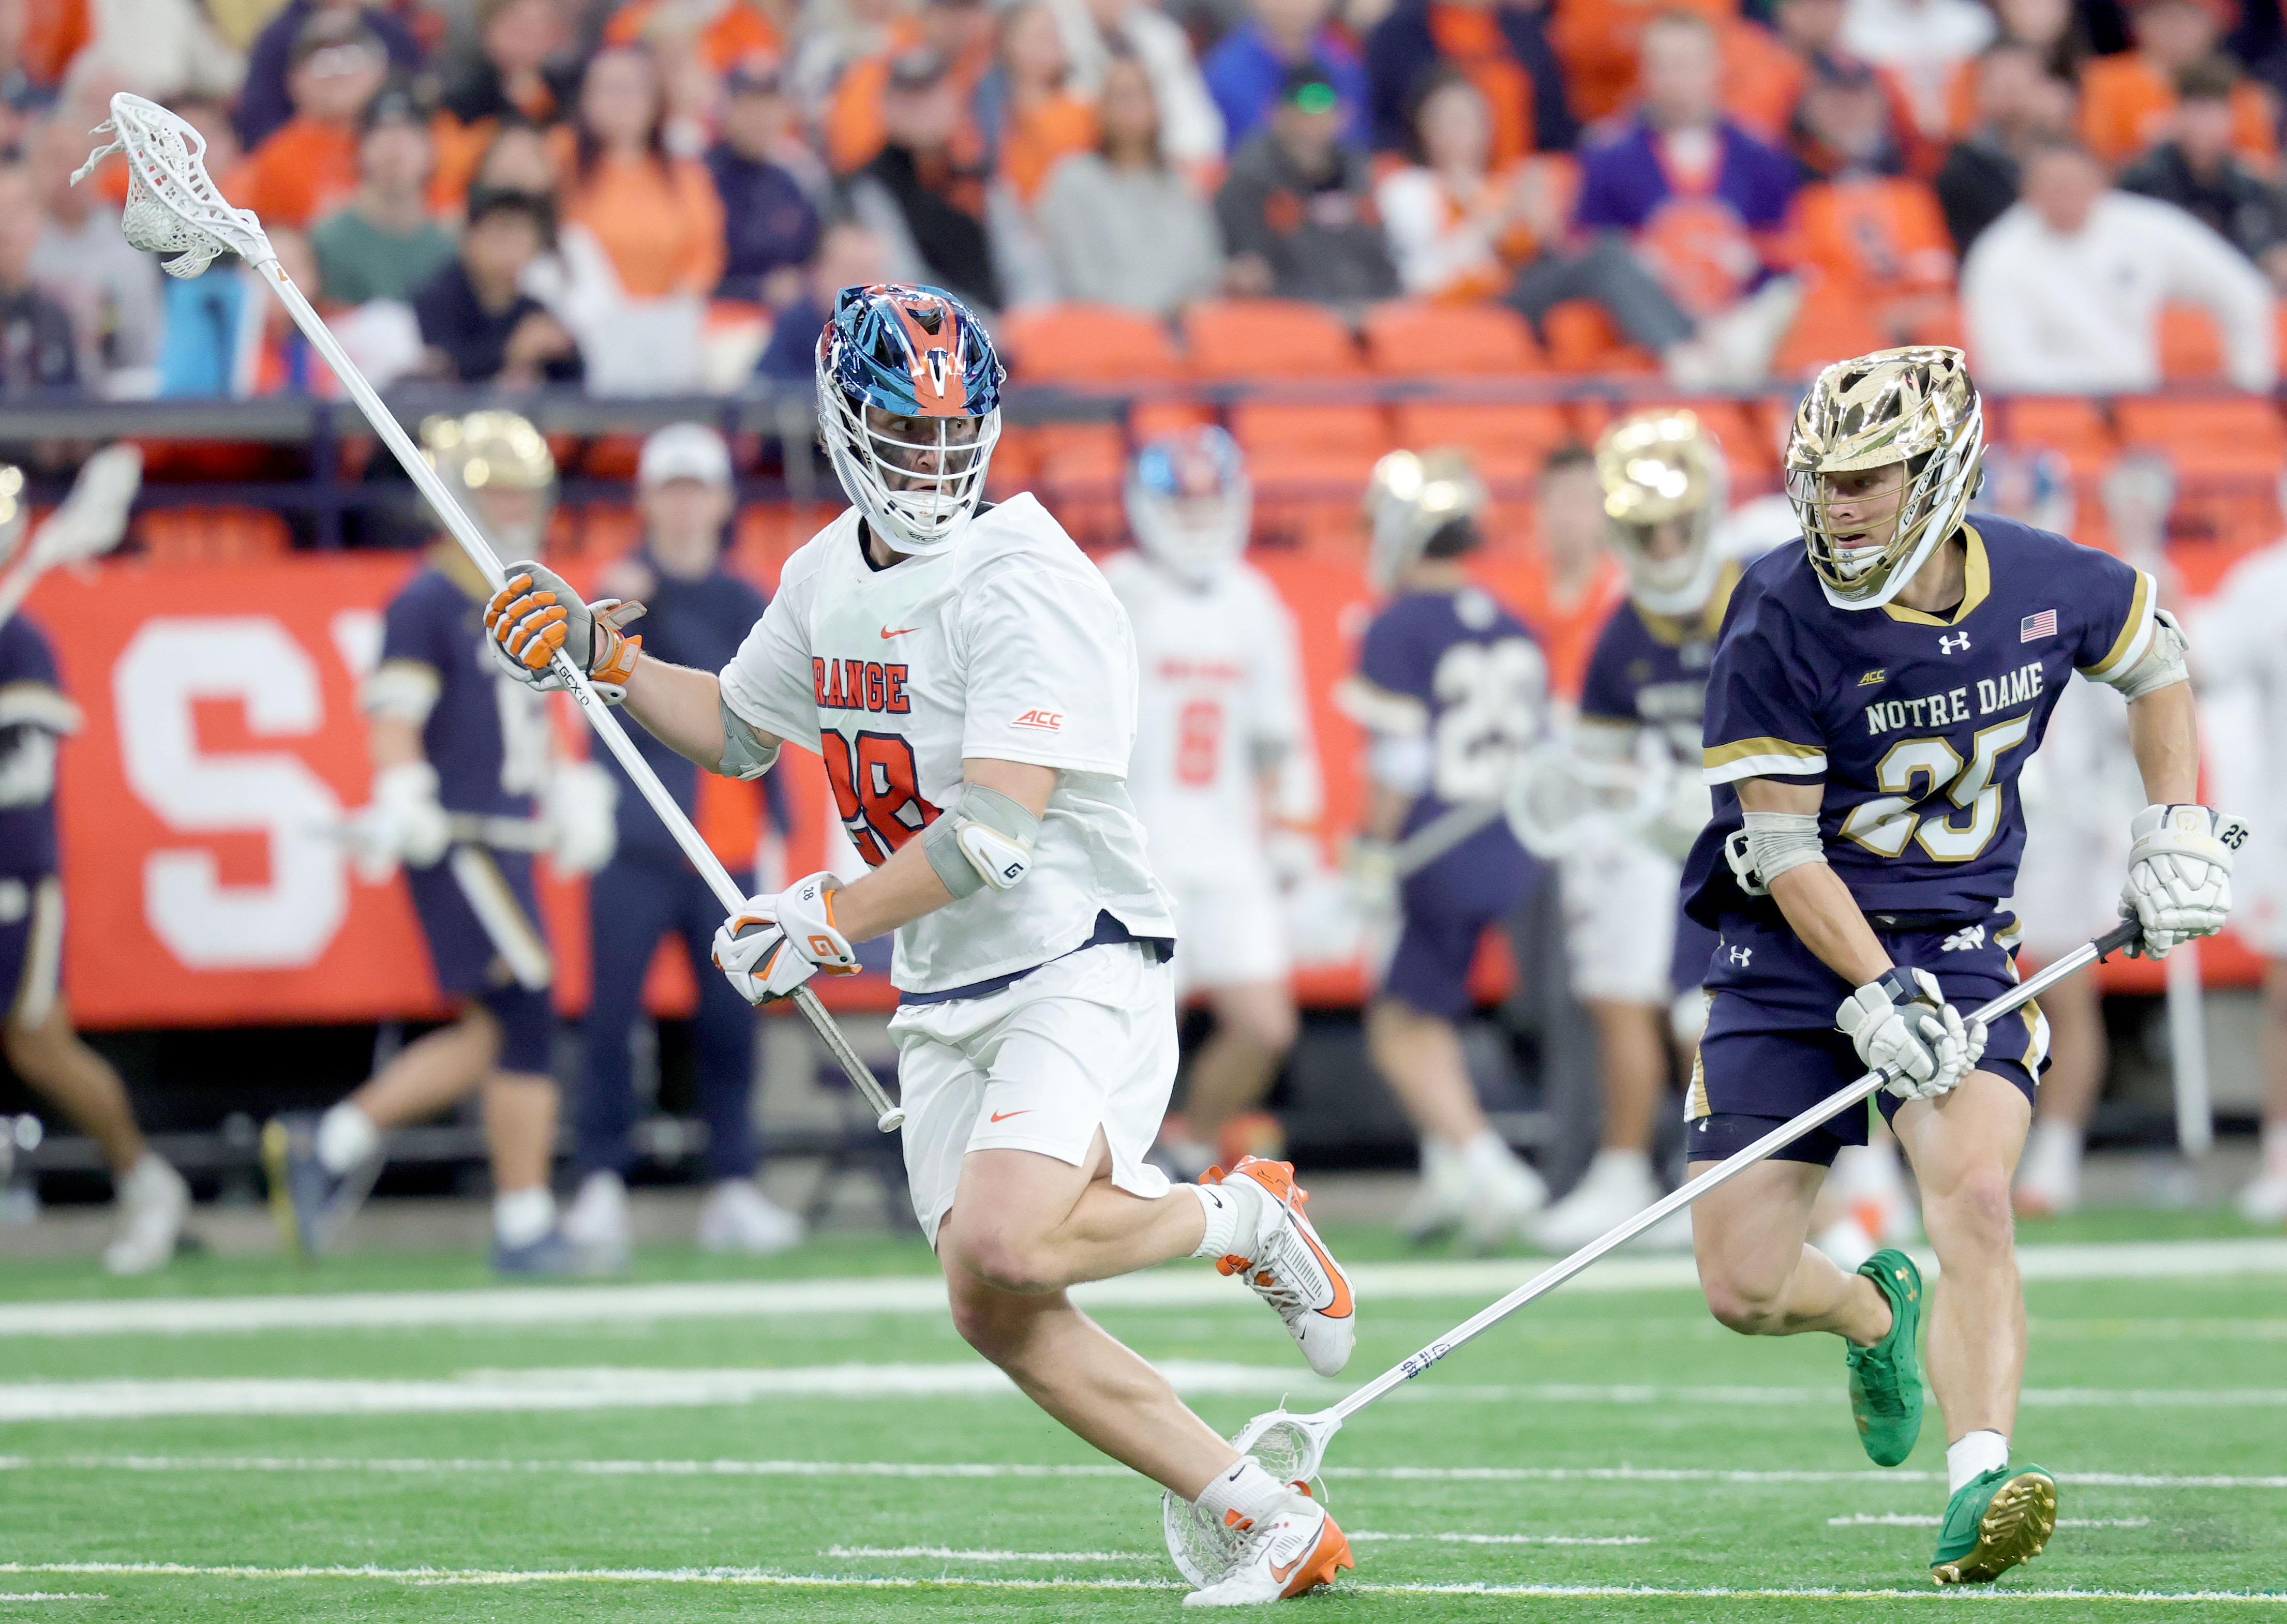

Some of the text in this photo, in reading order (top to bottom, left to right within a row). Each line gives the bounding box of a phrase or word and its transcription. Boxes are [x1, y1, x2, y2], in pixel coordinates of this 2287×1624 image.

[812, 657, 911, 714] RANGE
[1859, 669, 1885, 685] ACC
[1016, 710, 1064, 727] ACC
[1865, 661, 2044, 735] NOTRE DAME
[110, 610, 384, 972] S
[1837, 708, 2034, 862] 25
[2220, 824, 2249, 850] 25
[803, 886, 814, 901] 28
